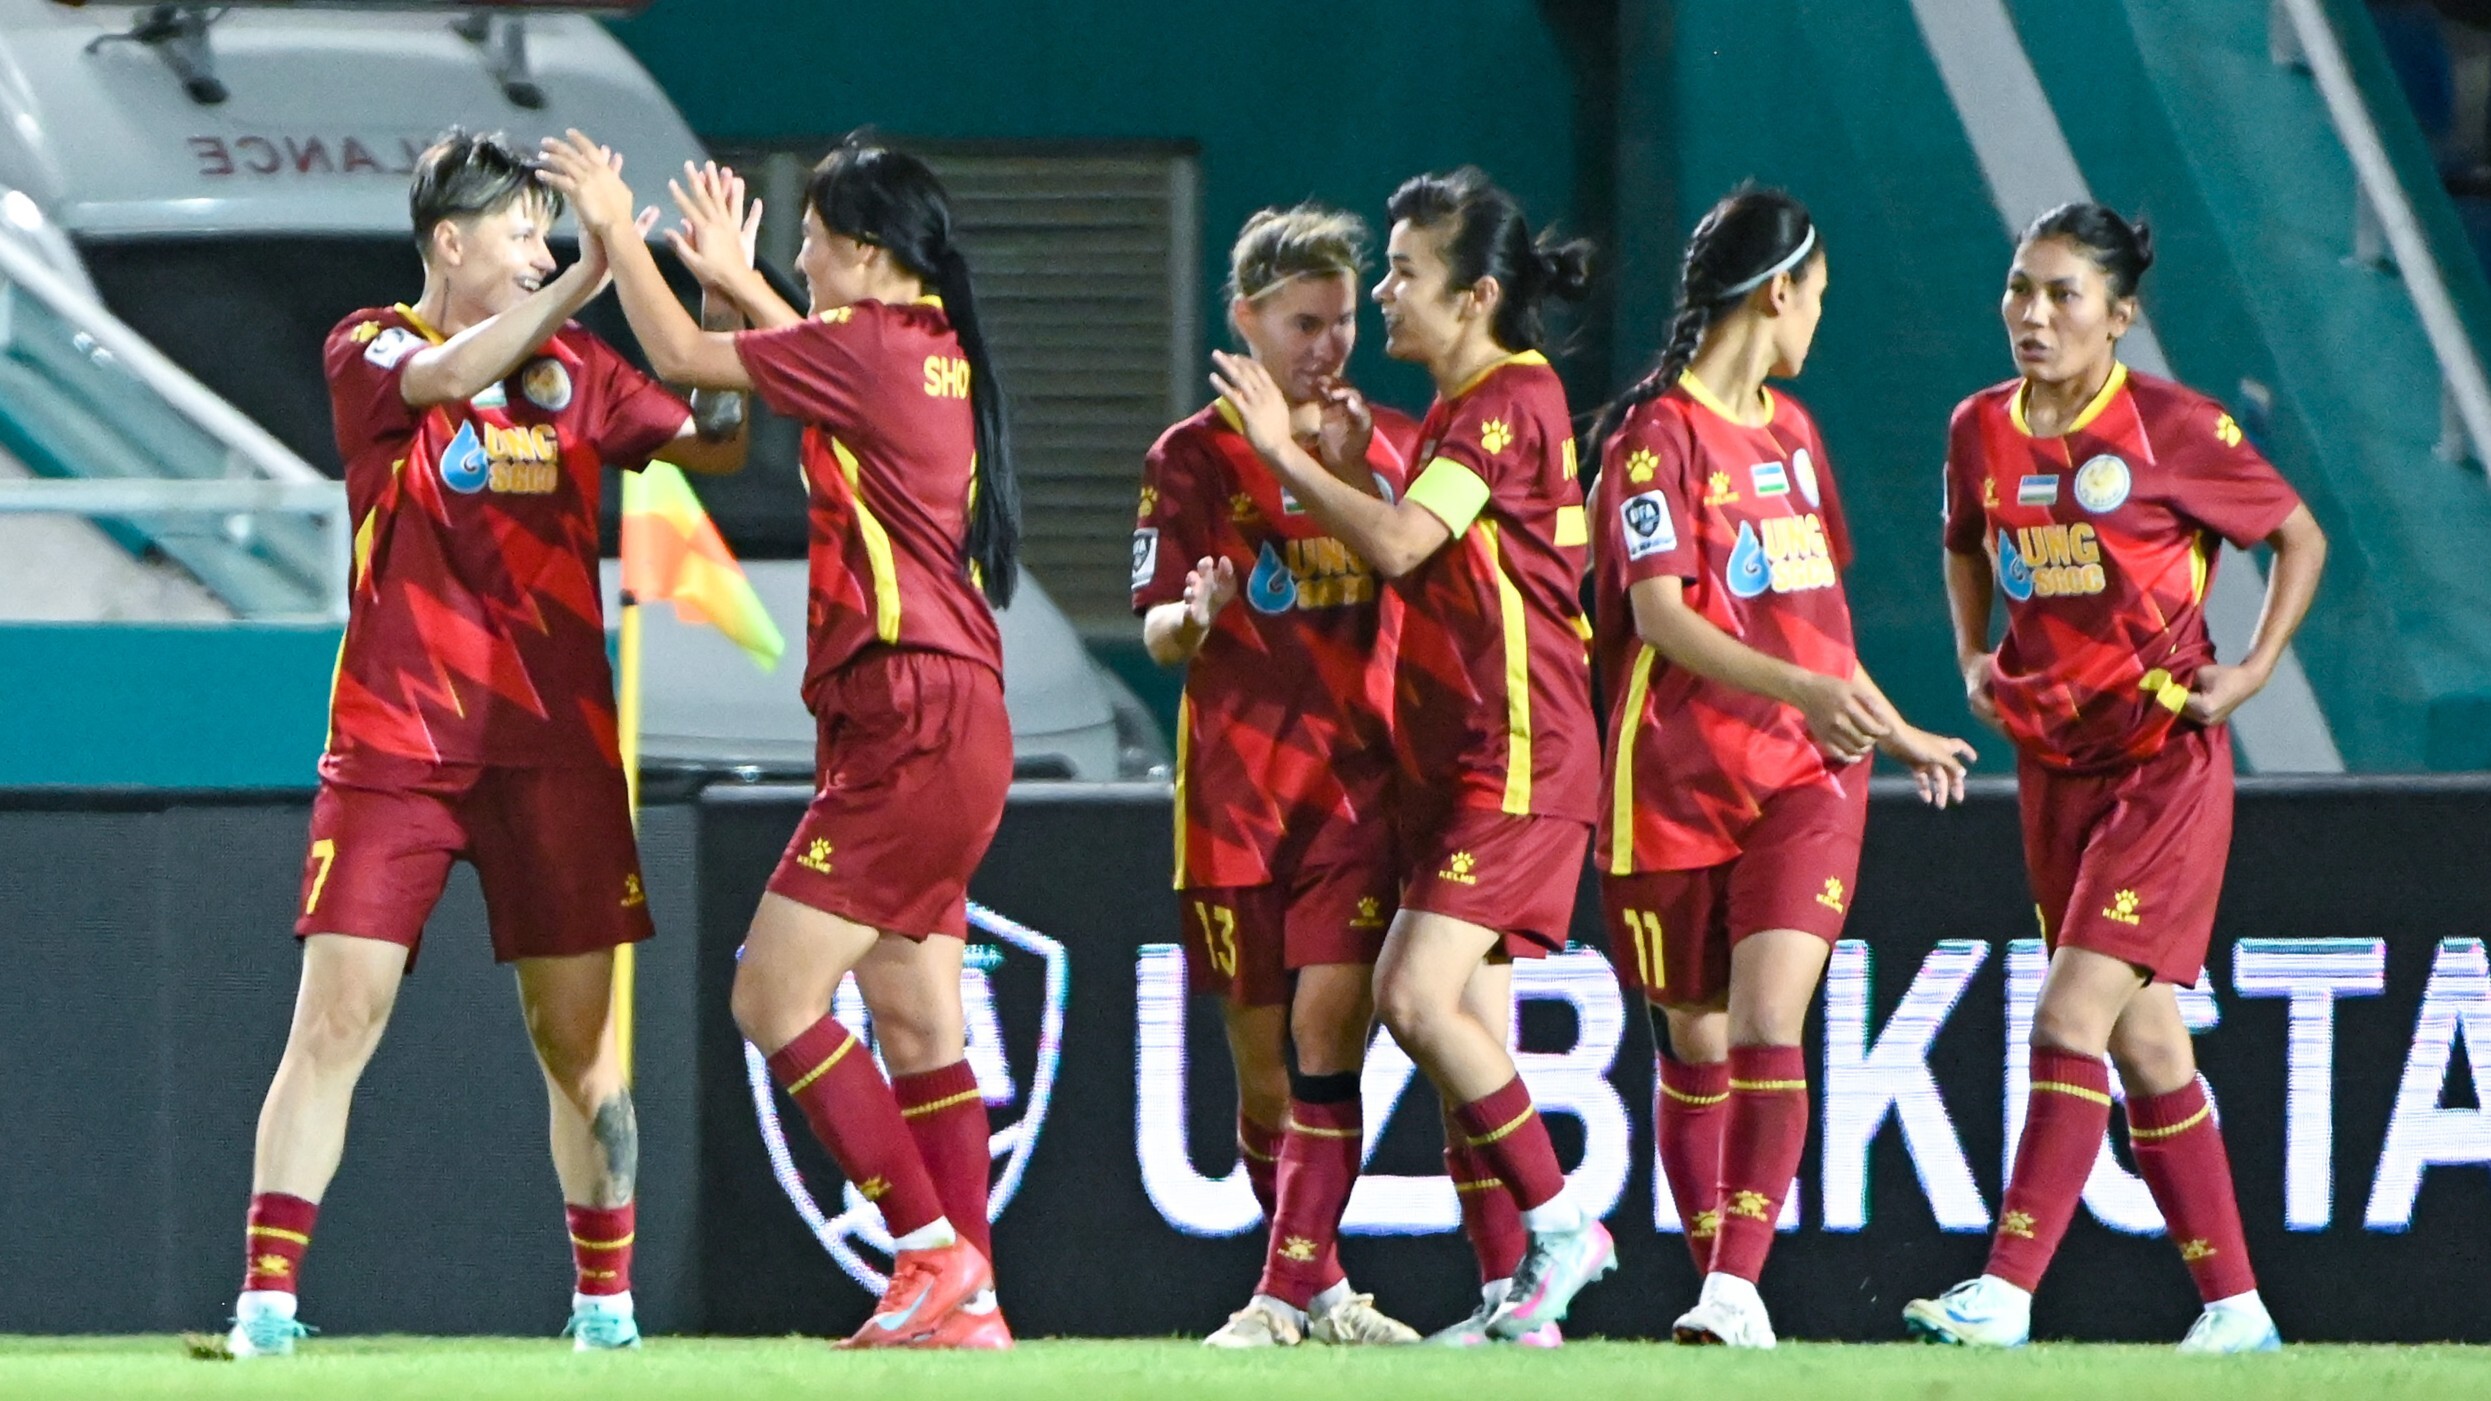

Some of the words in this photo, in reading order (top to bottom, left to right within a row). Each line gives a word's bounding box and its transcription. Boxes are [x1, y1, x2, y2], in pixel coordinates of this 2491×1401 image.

[484, 422, 559, 462] UNG
[1761, 513, 1828, 560] UNG
[2017, 522, 2100, 567] UNG
[306, 838, 335, 915] 7
[1194, 901, 1236, 978] 13
[1623, 907, 1665, 989] 11
